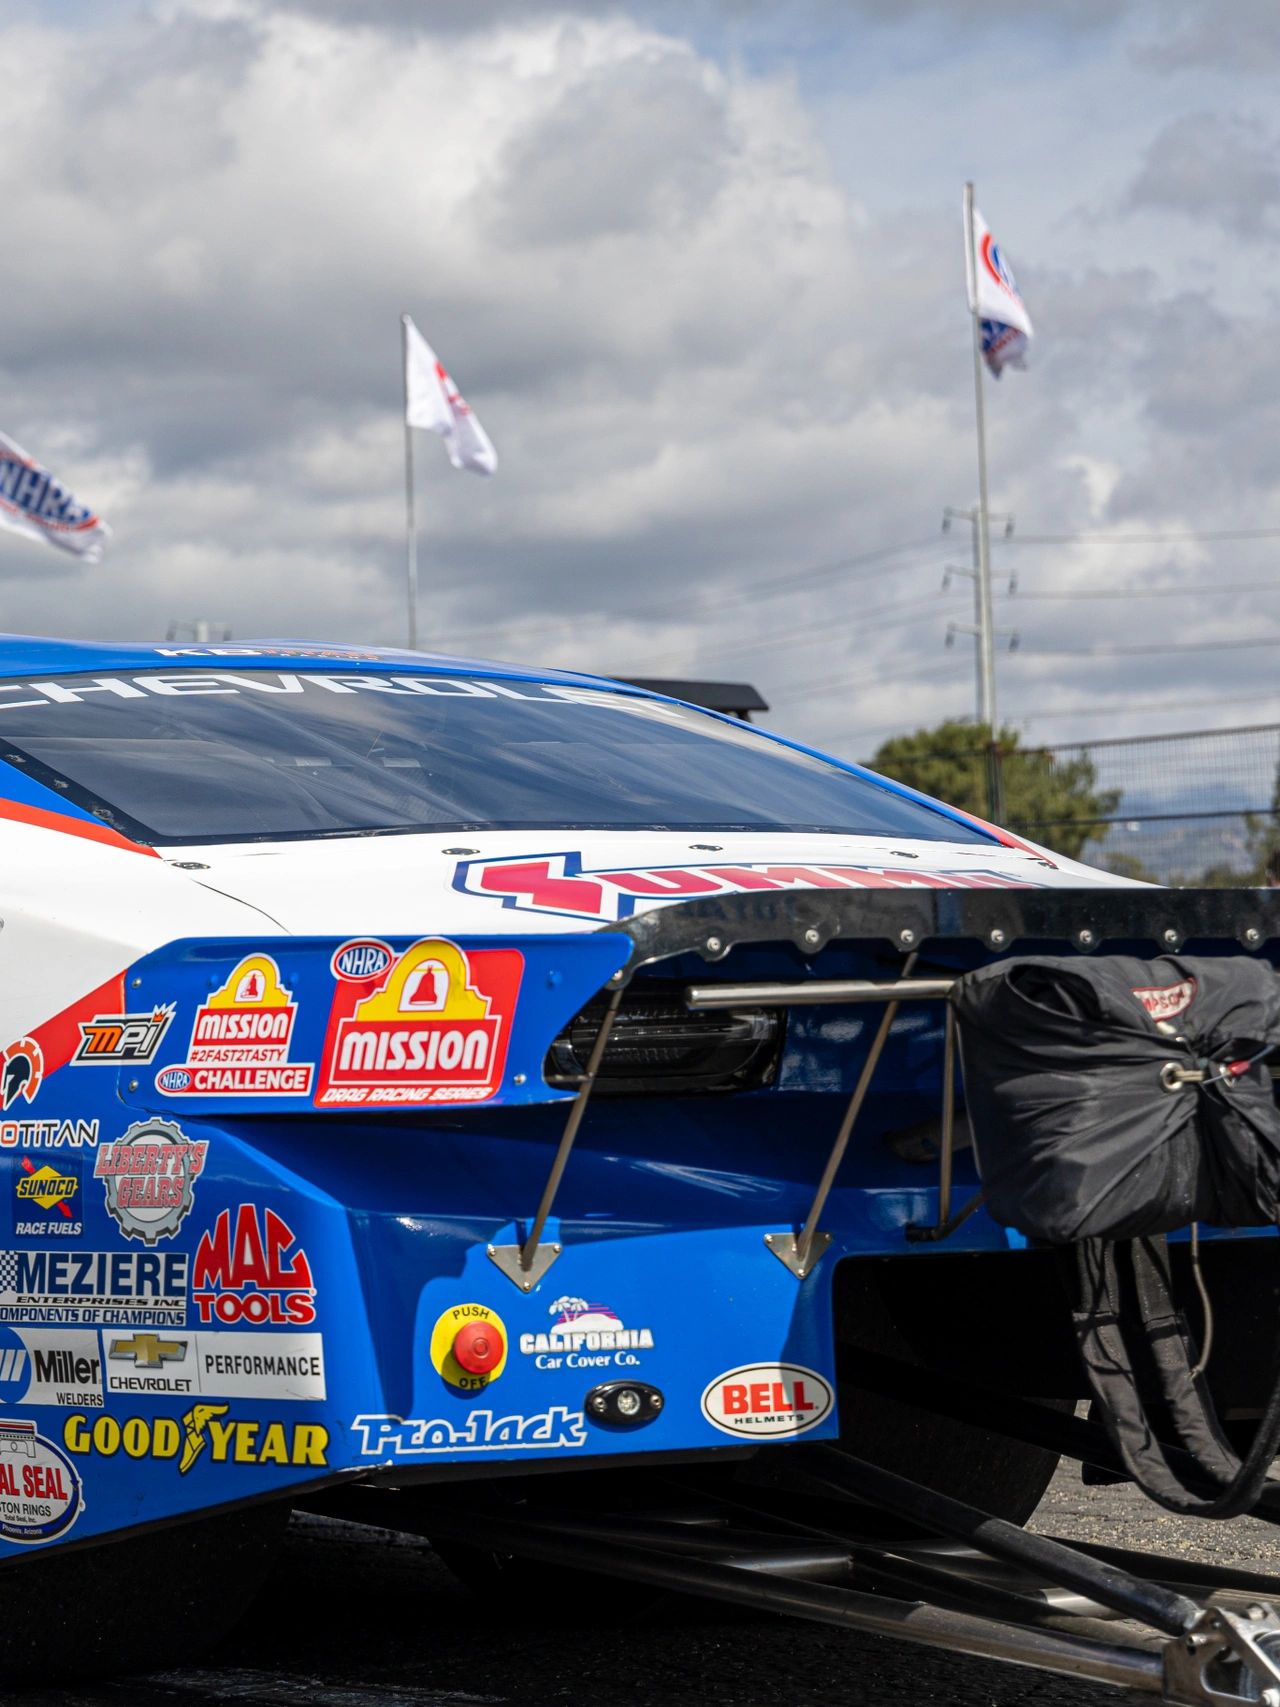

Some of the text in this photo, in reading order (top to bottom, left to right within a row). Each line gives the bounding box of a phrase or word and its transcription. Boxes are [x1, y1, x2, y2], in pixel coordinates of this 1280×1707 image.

[341, 948, 386, 975] NHRA
[196, 1012, 289, 1041] MISSION
[190, 1048, 286, 1063] #2FAST2TASTY
[338, 1029, 490, 1071] MISSION
[161, 1070, 307, 1091] NHRA CHALLENGE
[320, 1087, 493, 1102] DRAG RACING SERIES
[95, 1142, 206, 1176] LIBERTY'S
[20, 1180, 76, 1196] SUNOCO
[117, 1176, 185, 1209] GEARS
[16, 1222, 82, 1236] RACE FUELS
[193, 1204, 313, 1289] MAC
[17, 1252, 187, 1297] MEZIERE
[16, 1296, 185, 1308] ENTERPRISES INC
[193, 1293, 316, 1324] TOOLS
[452, 1306, 490, 1321] PUSH
[82, 1309, 101, 1323] OF
[103, 1310, 185, 1326] CHAMPIONS
[520, 1329, 654, 1354] CALIFORNIA
[33, 1350, 101, 1384] Miller
[535, 1350, 641, 1370] Car Cover Co.
[109, 1354, 321, 1392] CHEVROLET PERFORMANCE
[458, 1376, 487, 1390] OFF
[56, 1392, 104, 1407] WELDERS
[722, 1381, 814, 1415] BELL
[734, 1414, 805, 1424] HELMETS
[23, 1465, 68, 1501] SEAL
[22, 1504, 51, 1517] RINGS
